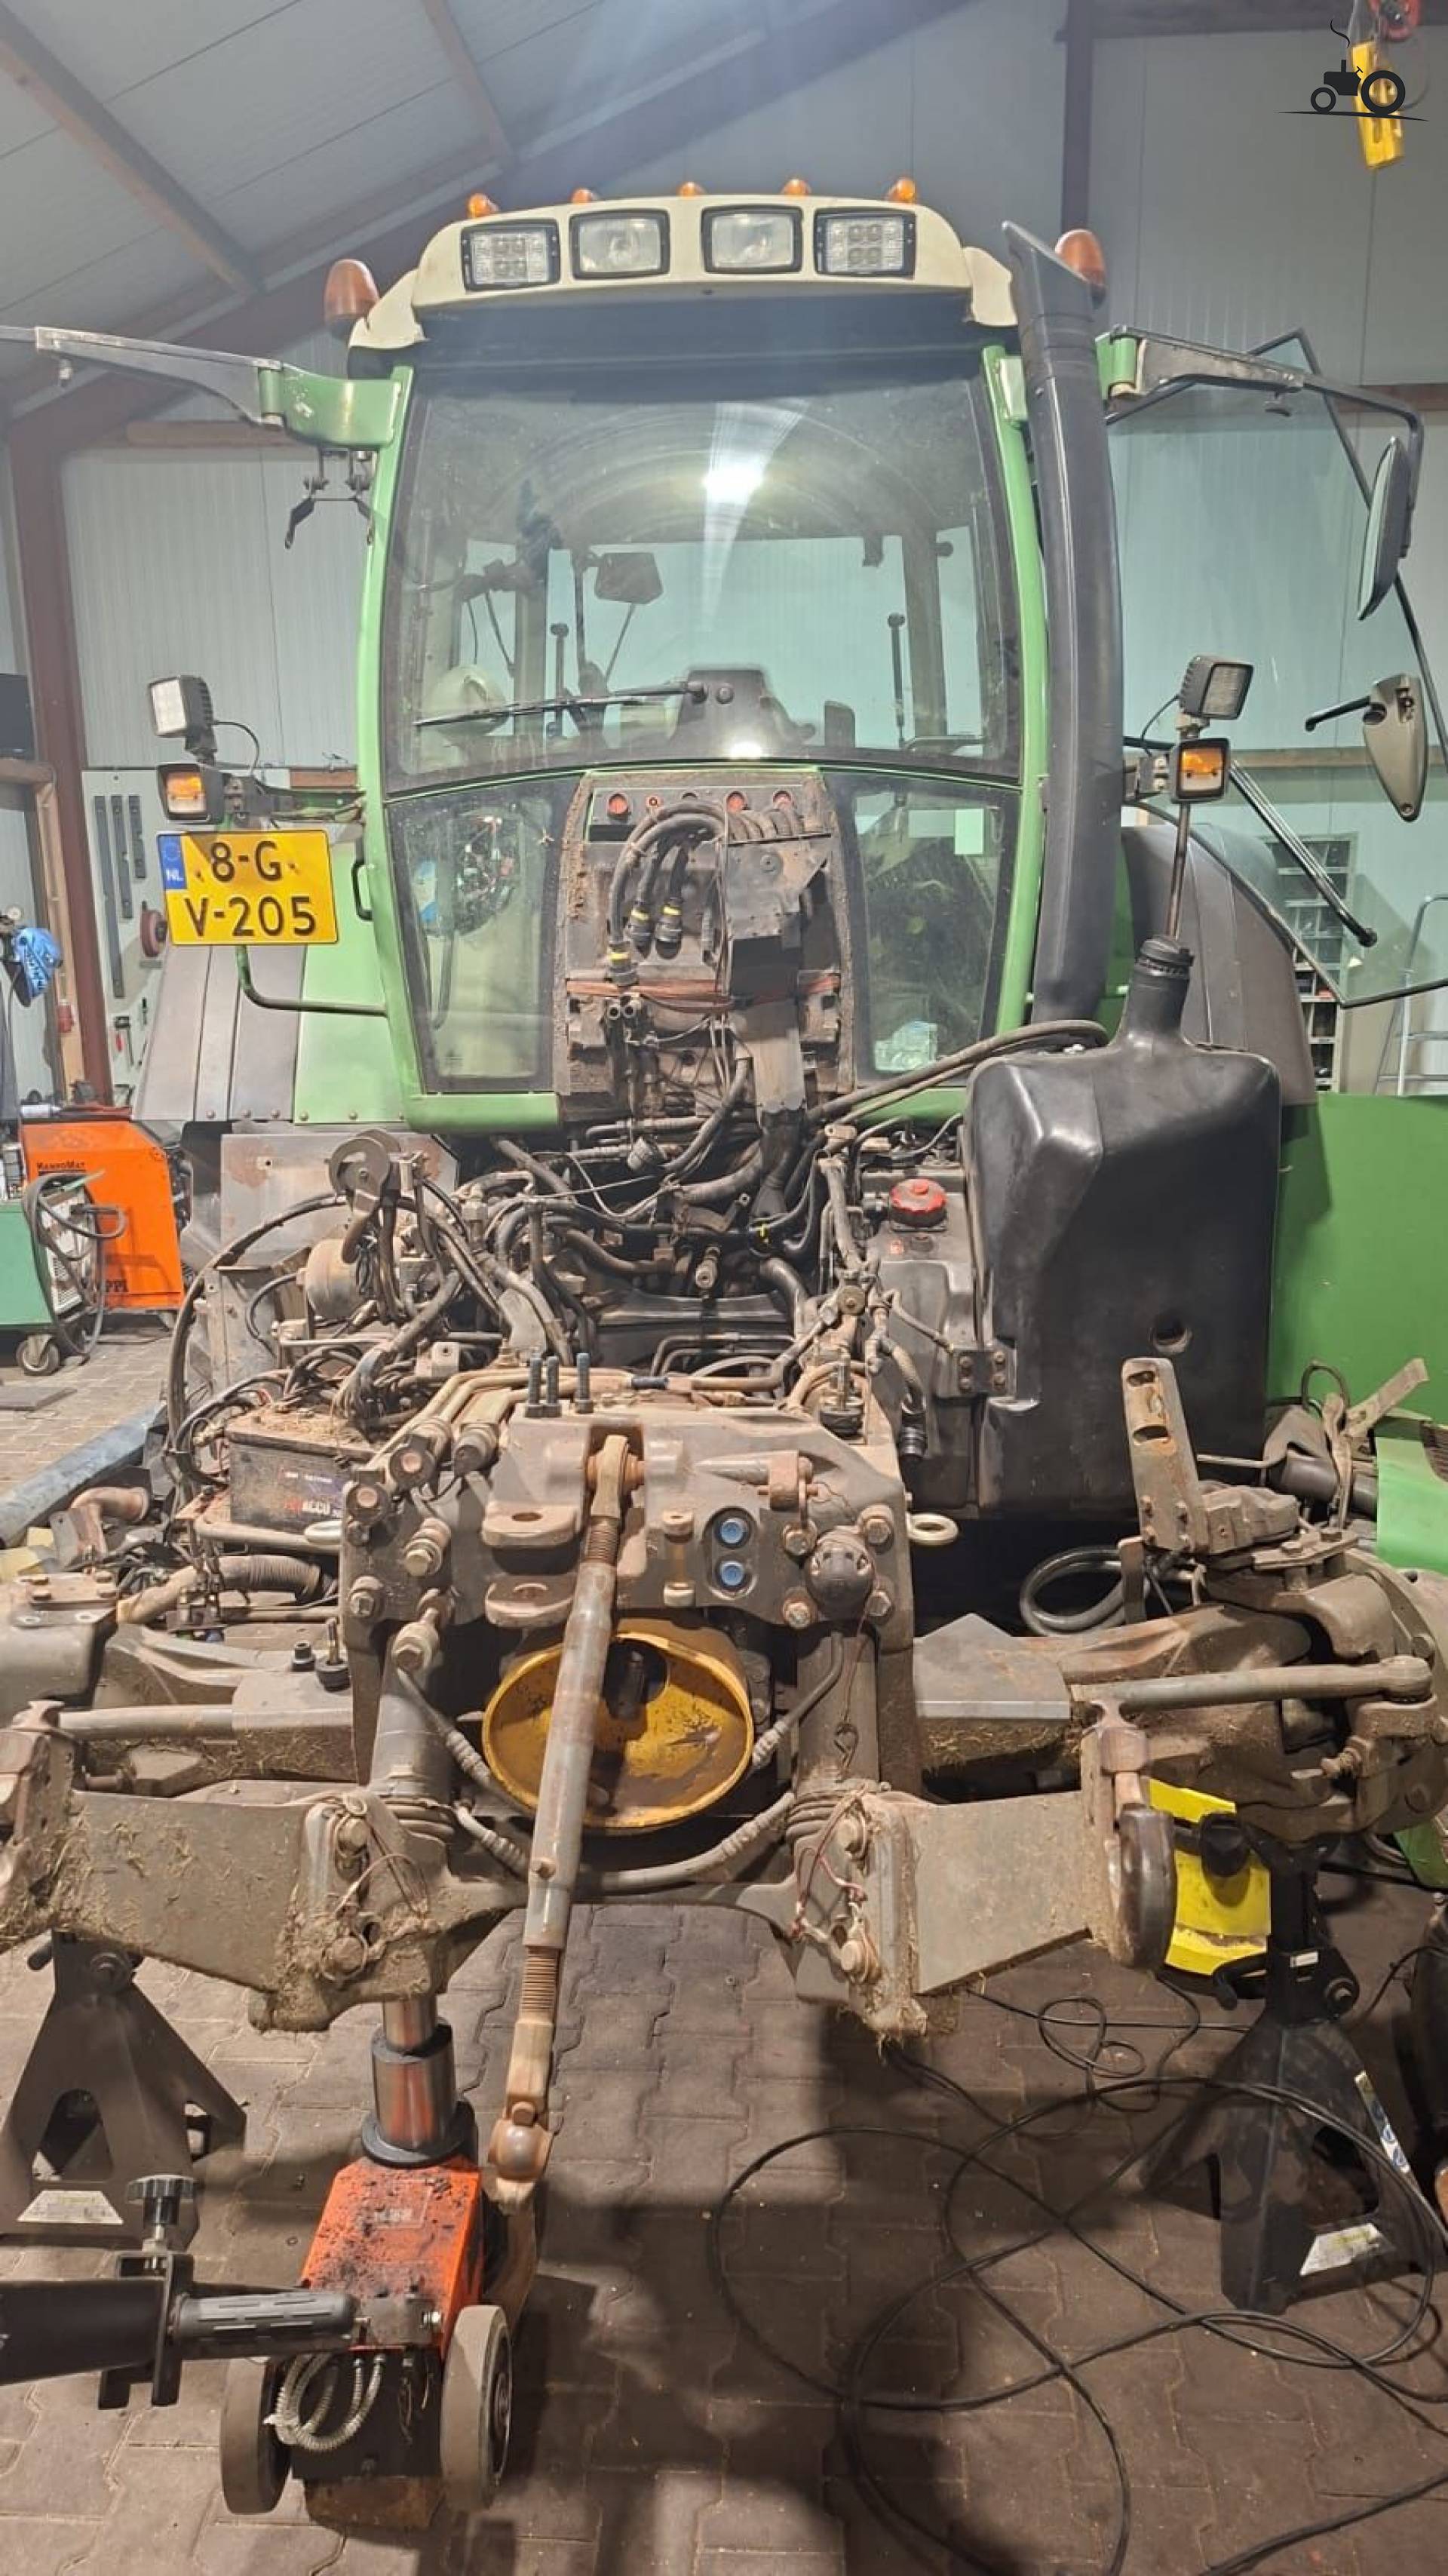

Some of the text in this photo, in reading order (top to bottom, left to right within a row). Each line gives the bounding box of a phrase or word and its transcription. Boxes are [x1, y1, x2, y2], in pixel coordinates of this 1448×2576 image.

[165, 869, 184, 882] NL
[210, 840, 283, 883] 8-G
[184, 895, 317, 937] V-205
